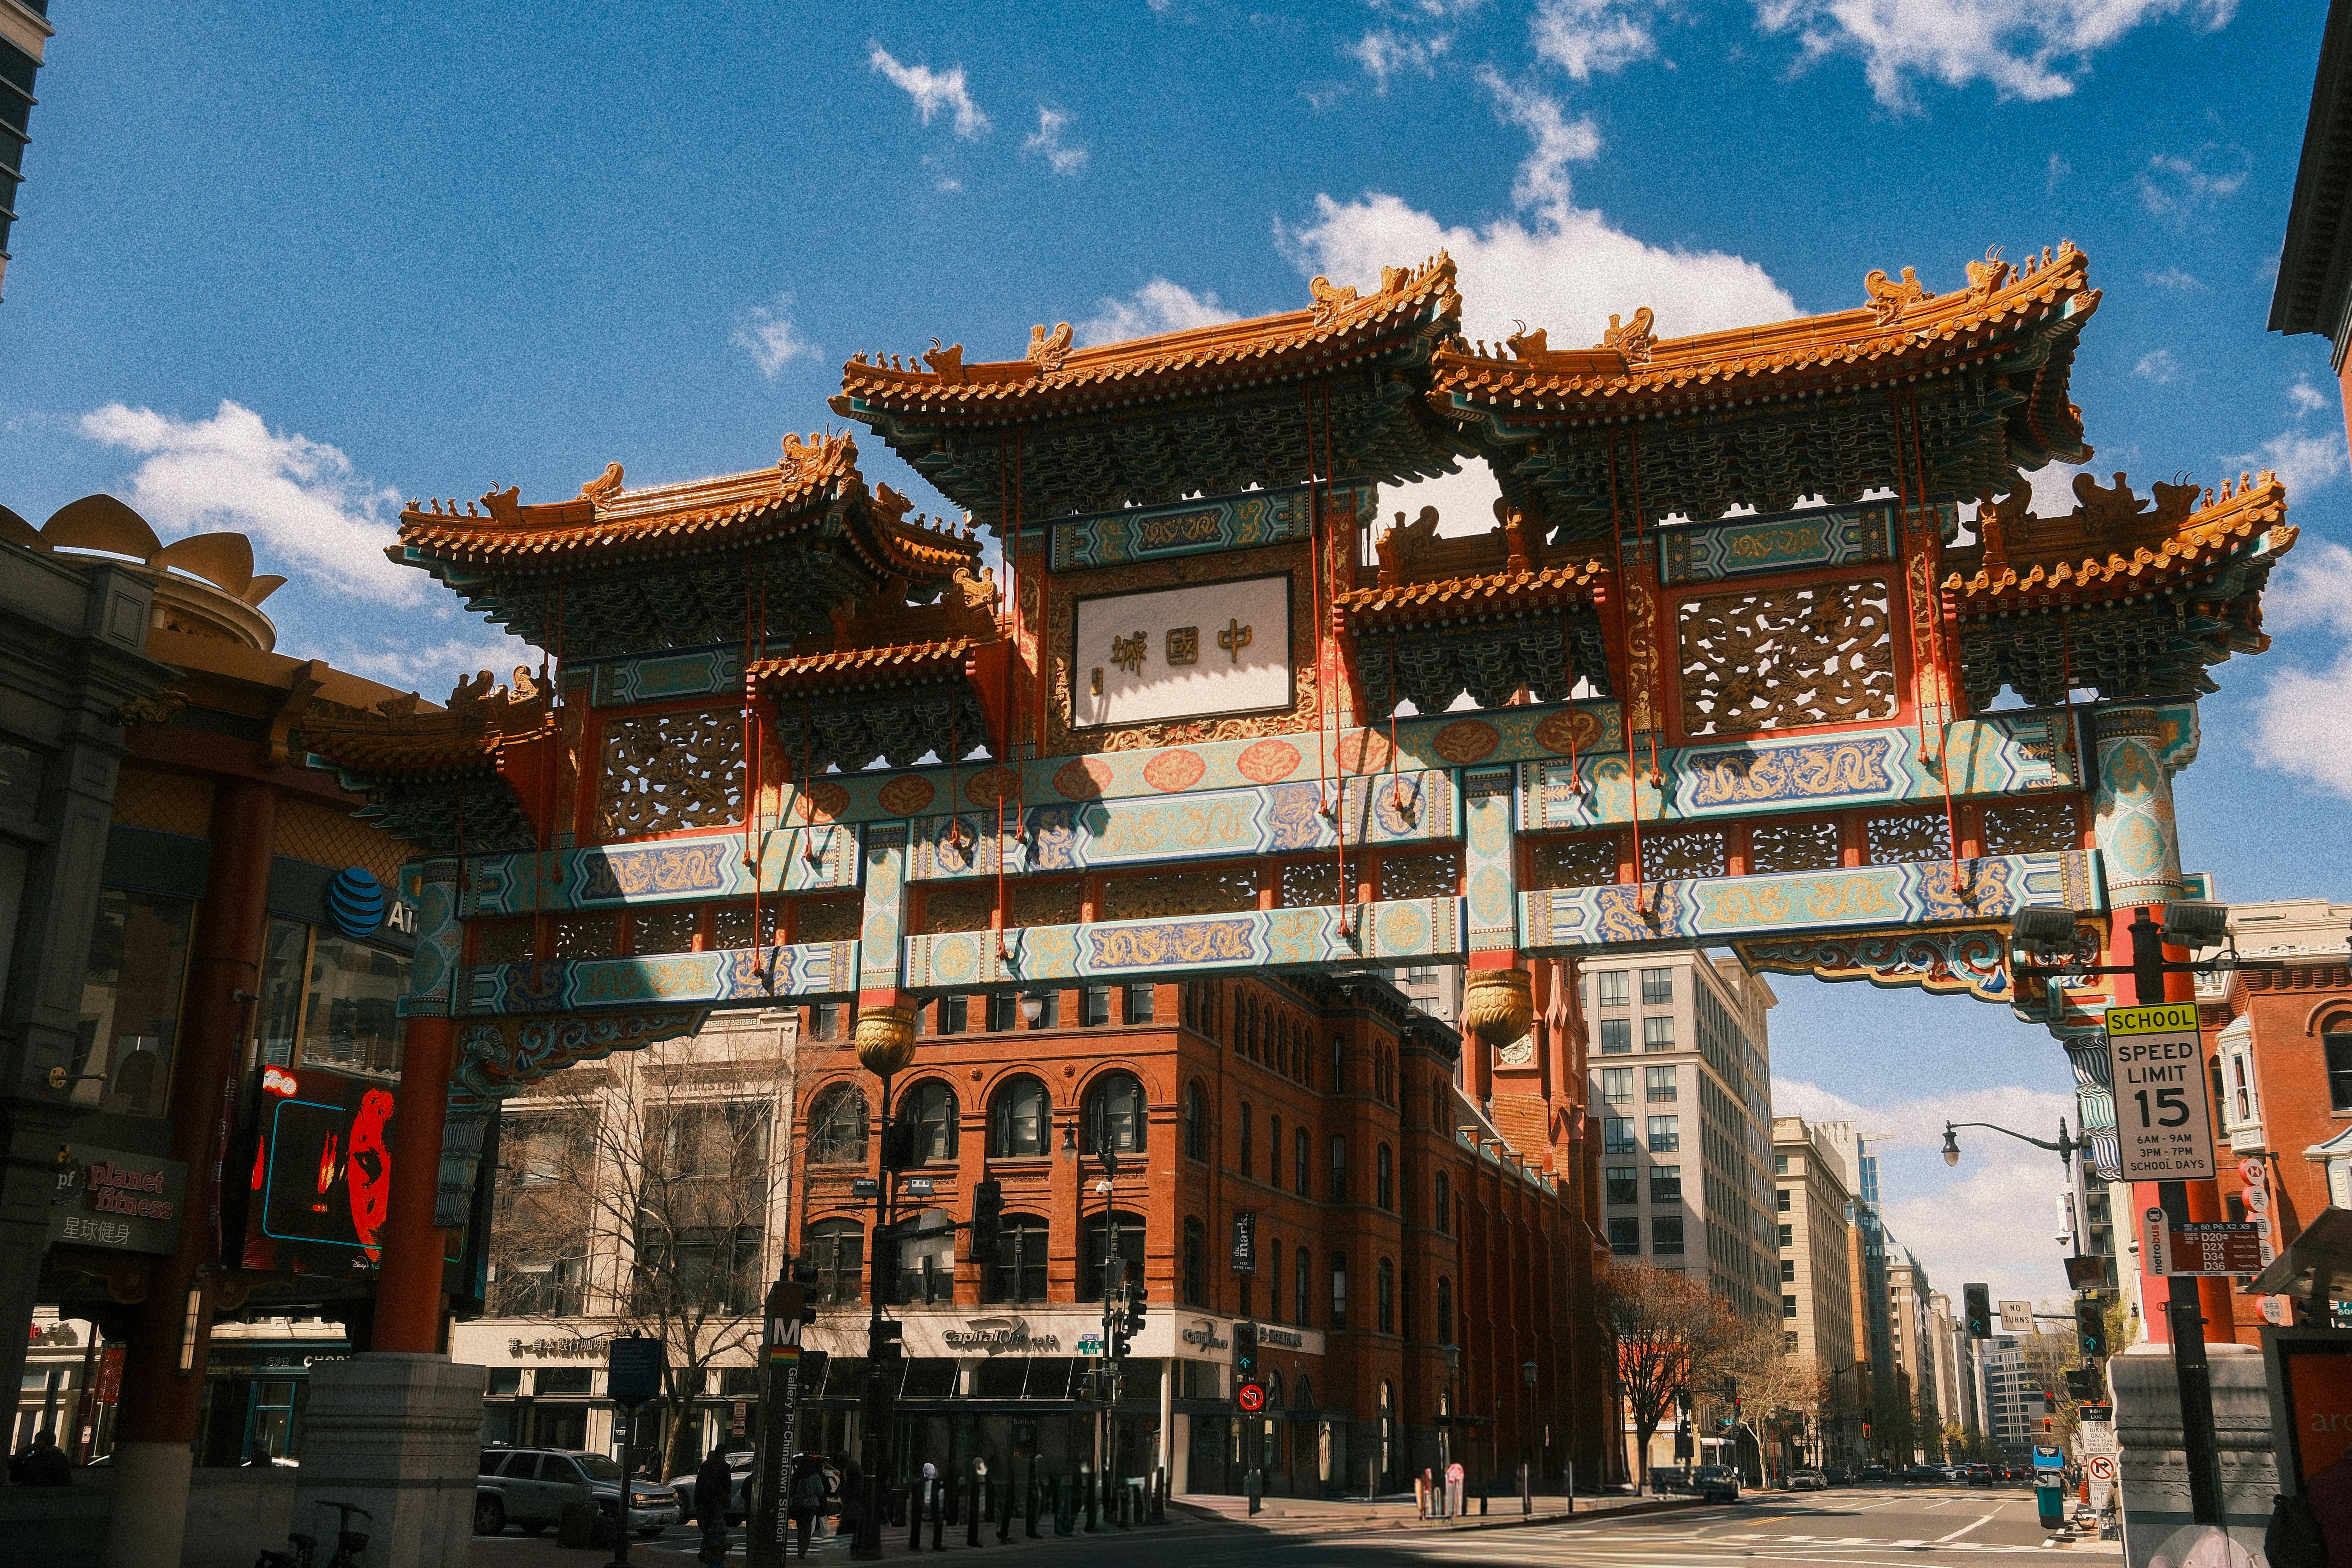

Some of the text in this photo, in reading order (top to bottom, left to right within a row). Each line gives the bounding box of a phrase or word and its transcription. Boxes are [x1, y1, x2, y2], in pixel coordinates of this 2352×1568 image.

[2112, 1010, 2194, 1030] SCHOOL
[2119, 1042, 2193, 1062] SPEED
[2127, 1065, 2186, 1084] LIMIT
[2134, 1087, 2190, 1128] 15
[2137, 1135, 2159, 1144] 6AM
[2169, 1134, 2192, 1143] 9AM
[2140, 1148, 2161, 1157] 3PM
[2171, 1147, 2193, 1156] 7PM
[2131, 1160, 2204, 1170] SCHOOL DAYS
[56, 1171, 76, 1189] pf
[89, 1161, 164, 1193] planet
[95, 1187, 173, 1219] fitness
[62, 1216, 131, 1245] 星球健身
[2201, 1233, 2222, 1241] D20
[2151, 1224, 2163, 1275] metrobus
[2202, 1242, 2225, 1251] D2X
[2203, 1252, 2224, 1260] D34
[2204, 1262, 2226, 1270] D36
[2004, 1316, 2029, 1324] TURNS
[773, 1318, 800, 1345] M
[508, 1338, 610, 1352] 第一資本銀行咖啡
[1013, 1418, 1037, 1426] banking
[776, 1367, 798, 1542] Gallery Pl-Chinatown Station
